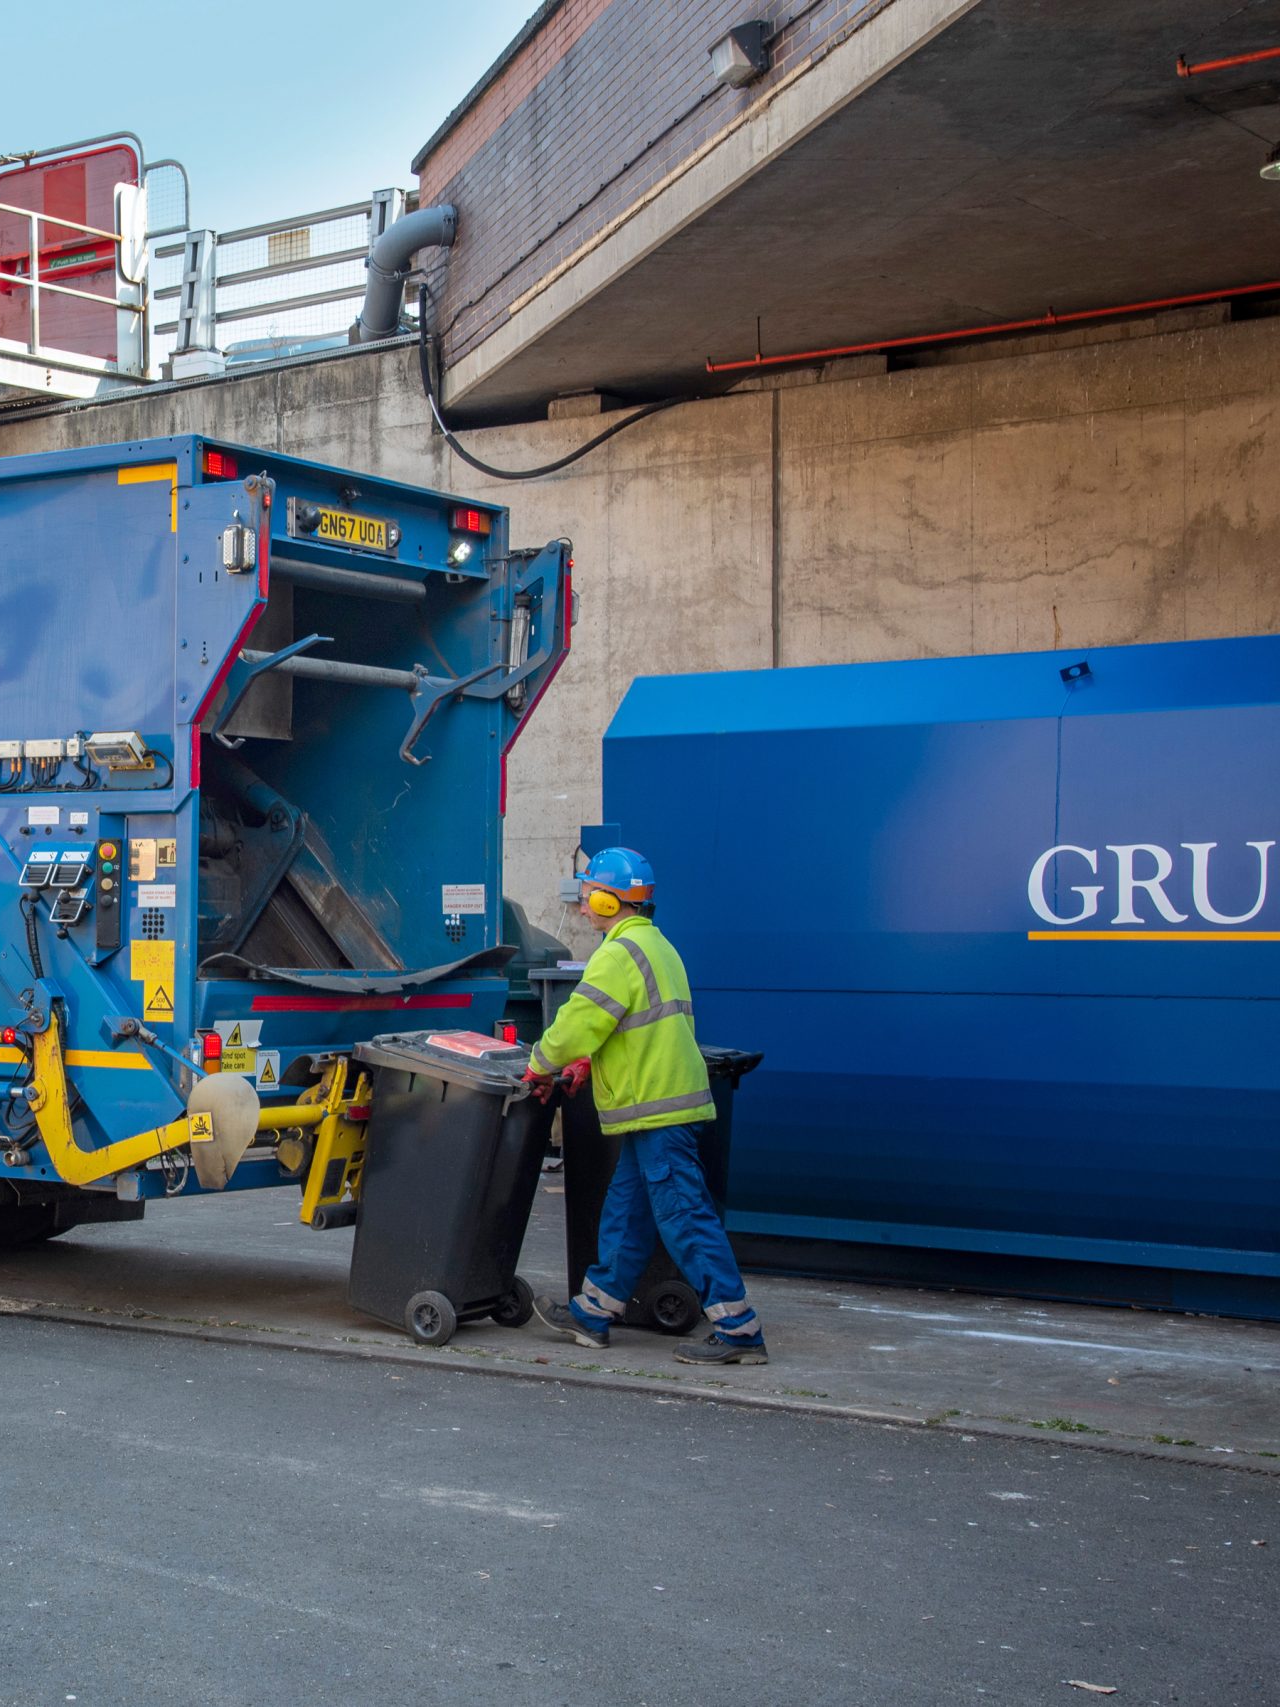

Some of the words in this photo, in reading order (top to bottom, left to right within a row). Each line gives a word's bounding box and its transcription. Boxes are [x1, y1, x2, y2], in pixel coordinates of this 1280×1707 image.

[320, 512, 355, 539] GN67
[359, 519, 383, 545] UOA
[1028, 840, 1276, 925] GRU
[234, 1052, 246, 1062] spot
[234, 1062, 246, 1070] care
